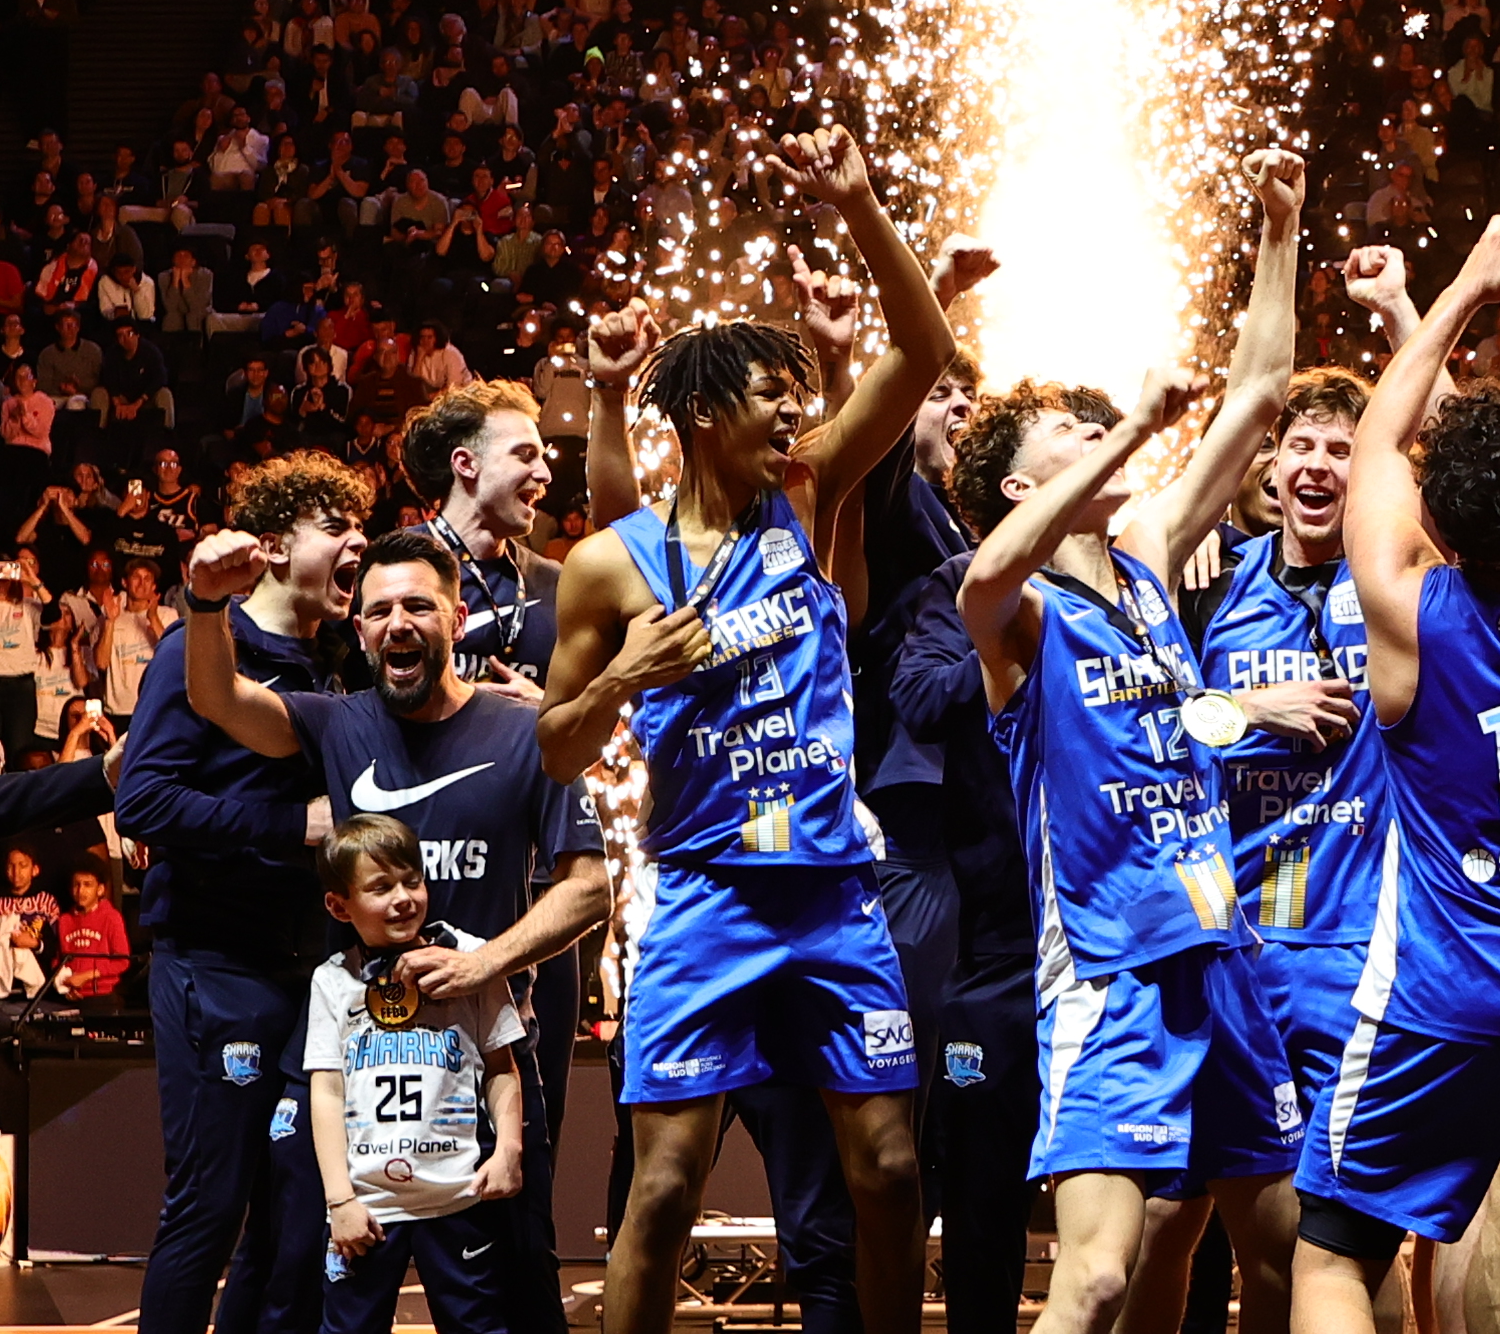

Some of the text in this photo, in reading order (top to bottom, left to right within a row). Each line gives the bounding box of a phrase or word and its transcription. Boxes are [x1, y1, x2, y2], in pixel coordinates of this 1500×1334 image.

[762, 546, 802, 568] KING
[1331, 602, 1363, 617] KIN
[736, 652, 786, 706] 13
[688, 707, 797, 757] Travel
[1138, 706, 1190, 763] 12
[728, 734, 841, 781] Planet
[1099, 770, 1206, 814] Travel
[1228, 763, 1333, 794] Travel
[1259, 795, 1367, 826] Planet
[419, 839, 489, 881] RKS
[345, 1028, 464, 1076] SHARKS
[945, 1043, 983, 1060] SHARKS
[668, 1069, 686, 1079] SUD
[375, 1074, 422, 1122] 25
[399, 1137, 459, 1154] Planet
[1133, 1133, 1153, 1143] SUD
